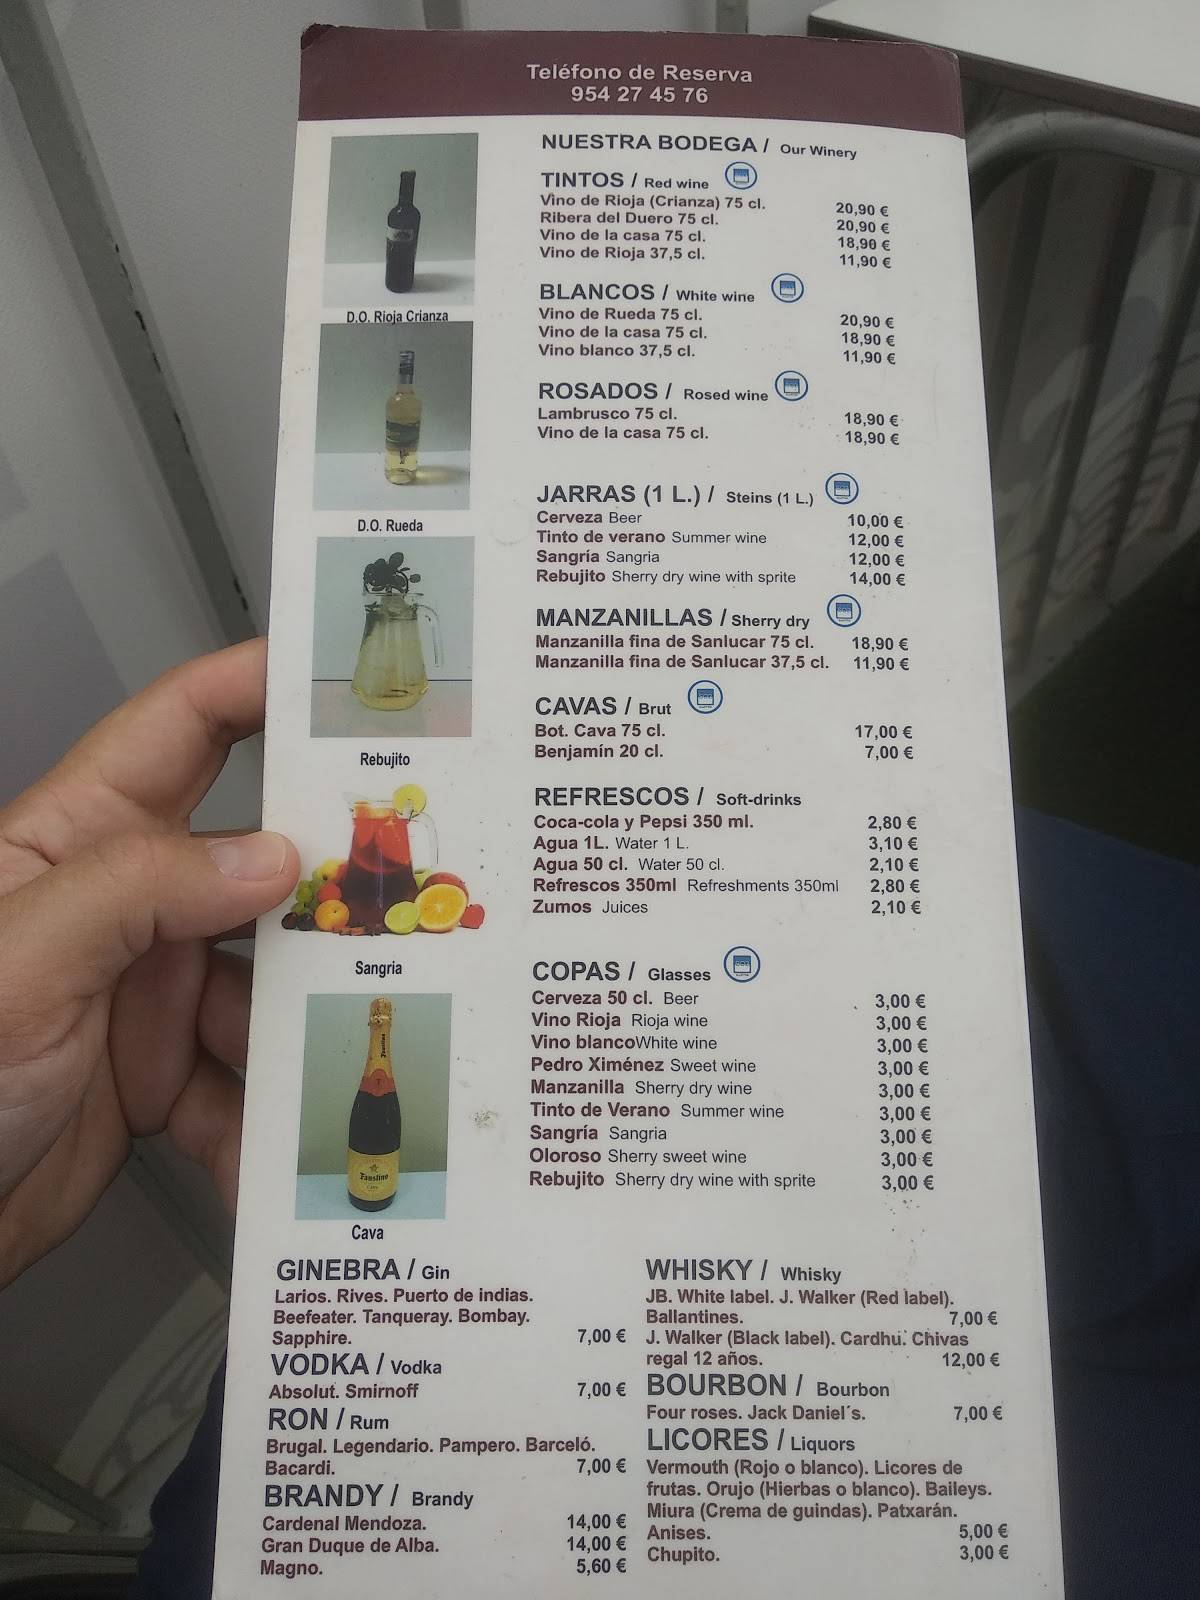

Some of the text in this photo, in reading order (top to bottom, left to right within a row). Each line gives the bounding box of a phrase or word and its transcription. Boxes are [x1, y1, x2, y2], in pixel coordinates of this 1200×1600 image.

[526, 64, 752, 82] Teléfono de Reserva
[571, 86, 708, 103] 954 27 45 76
[542, 133, 857, 161] NUESTRA BODEGA Our Winery
[541, 172, 709, 189] TINTOS Red wine
[540, 192, 765, 211] Vino de Rioja (Crianza) 75 cl.
[540, 211, 719, 225] Ribera del Duero 75 cl.
[837, 219, 890, 234] 20,90 €
[540, 283, 755, 303] BLANCOS White wine
[347, 310, 449, 325] D.O. Rioja Crianza
[539, 382, 768, 401] ROSADOS Rosed wine
[538, 407, 677, 420] Lambrusco 75 cl.
[844, 412, 899, 427] 18,90 €
[536, 485, 814, 508] JARRAS (1 L.) Steins (1 L.)
[358, 519, 423, 532] D.O. Rueda
[537, 510, 643, 524] Cerveza Beer
[848, 513, 904, 529] 10,00 €
[536, 549, 660, 566] Sangría Sangria
[536, 569, 796, 586] Rebujito Sherry dry wine with sprite
[850, 571, 906, 587] 14,00 €
[536, 608, 810, 630] MANZANILLAS Sherry dry
[536, 634, 814, 648] Manzanilla fina de Sanlucar 75 cl.
[852, 636, 909, 652] 18,90 €
[535, 696, 672, 716] CAVAS Brut
[360, 752, 410, 769] Rebujito
[535, 744, 663, 762] Benjamín 20 cl.
[865, 745, 914, 761] 7,00 €
[535, 786, 802, 806] REFRESCOS Soft-drinks
[534, 814, 754, 832] Coca-cola y Pepsi 350 ml.
[868, 815, 917, 832] 2,80 €
[533, 877, 839, 892] Refrescos 350ml Refreshments 350ml
[532, 899, 648, 914] Zumos Juices
[355, 960, 402, 978] Sangria
[532, 961, 711, 981] COPAS Glasses
[531, 1056, 756, 1073] Pedro Ximénez Sweet wine
[878, 1061, 929, 1078] 3,00 €
[352, 1224, 384, 1240] Cava
[276, 1258, 450, 1281] GINEBRA Gin
[645, 1258, 842, 1285] WHISKY Whisky
[273, 1308, 530, 1327] Beefeater. Tanqueray. Bombay.
[646, 1309, 743, 1324] Ballantines.
[270, 1353, 442, 1376] VODKA Vodka
[268, 1382, 419, 1399] Absolut. Smirnoff
[647, 1373, 890, 1397] BOURBON Bourbon
[268, 1407, 389, 1431] RON Rum
[647, 1404, 686, 1420] Four
[691, 1408, 742, 1420] roses.
[747, 1404, 787, 1420] Jack
[266, 1436, 595, 1458] Brugal. Legendario. Pampero. Barceló.
[648, 1428, 855, 1455] LICORES Liquors
[265, 1484, 474, 1510] BRANDY Brandy
[647, 1502, 957, 1522] Miura (Crema de guindas). Patxarán.
[647, 1524, 711, 1540] Anises.
[647, 1546, 720, 1565] Chupito.
[960, 1544, 1009, 1563] 3,00 €
[260, 1559, 323, 1579] Magno.
[576, 1558, 626, 1576] 5,60 €
